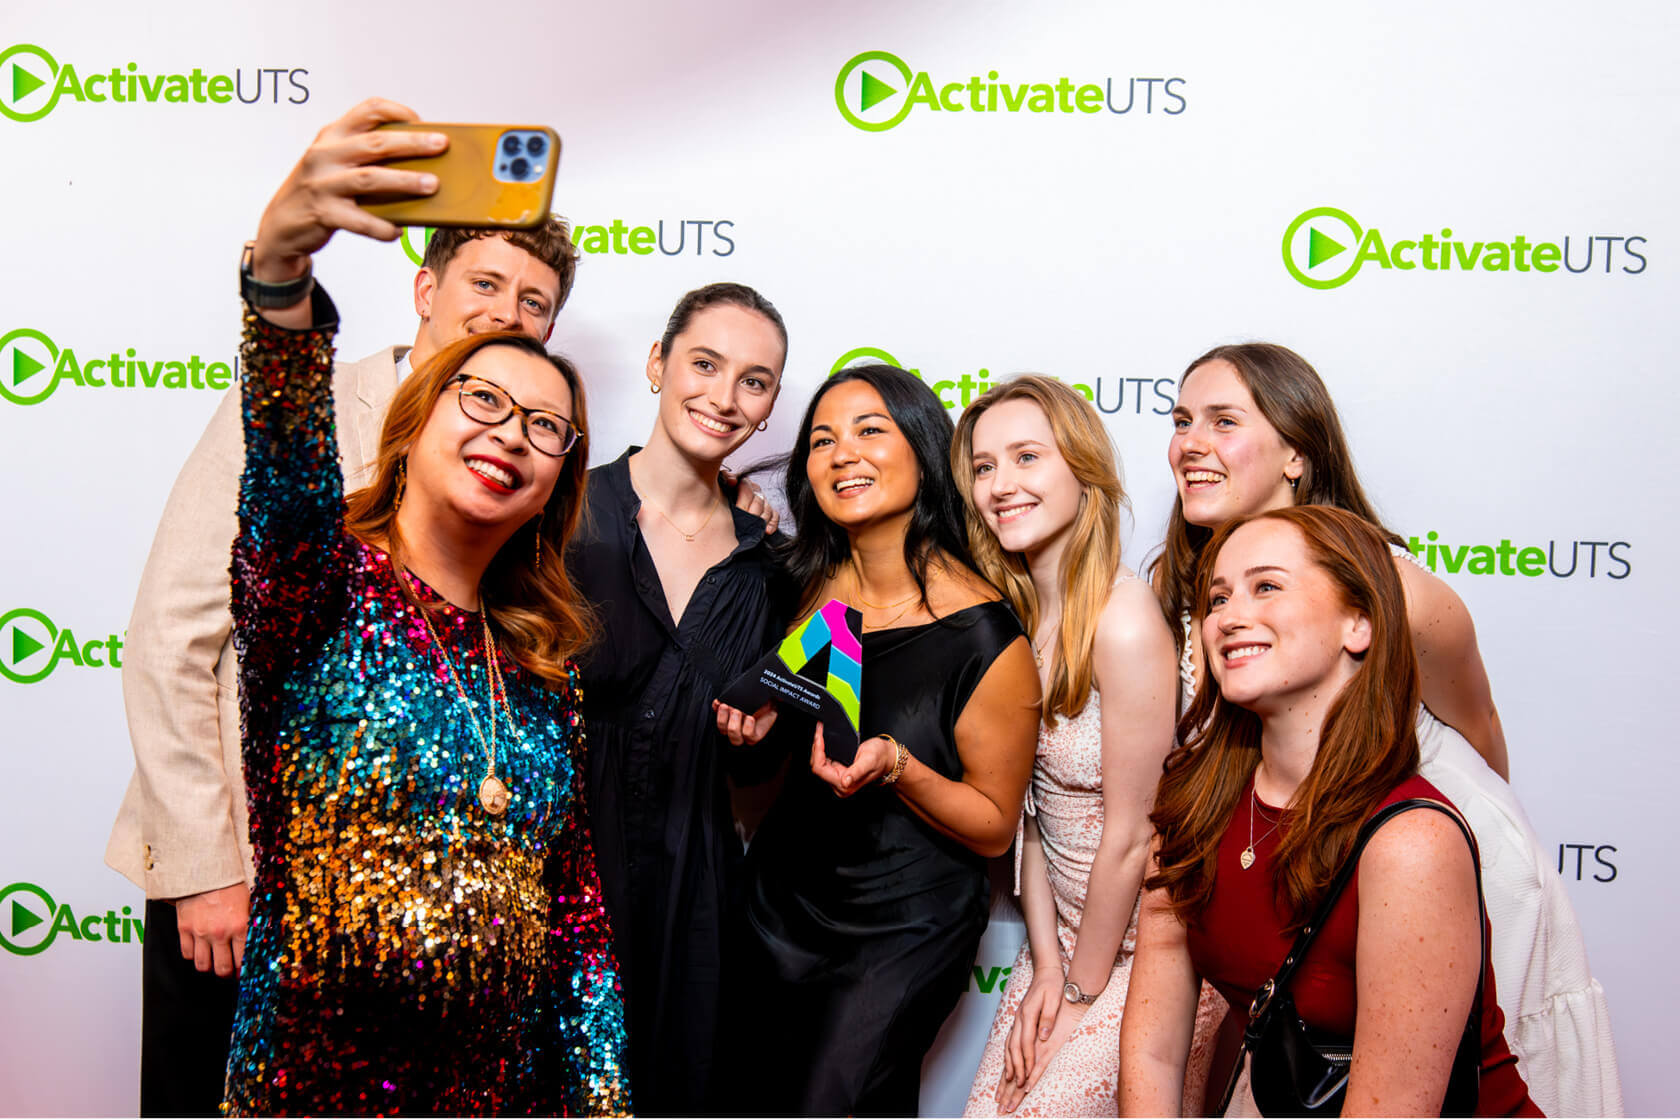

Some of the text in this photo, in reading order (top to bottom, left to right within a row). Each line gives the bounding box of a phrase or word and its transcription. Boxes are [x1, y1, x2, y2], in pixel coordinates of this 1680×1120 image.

[53, 62, 310, 104] ActivateUTS
[908, 70, 1187, 115] ActivateUTS
[1357, 228, 1648, 274] ActivateUTS
[55, 348, 238, 391] Activate
[1407, 530, 1632, 580] tivateUTS
[760, 676, 821, 710] SOCIAL IMPACT AWARD
[803, 689, 821, 700] Awards
